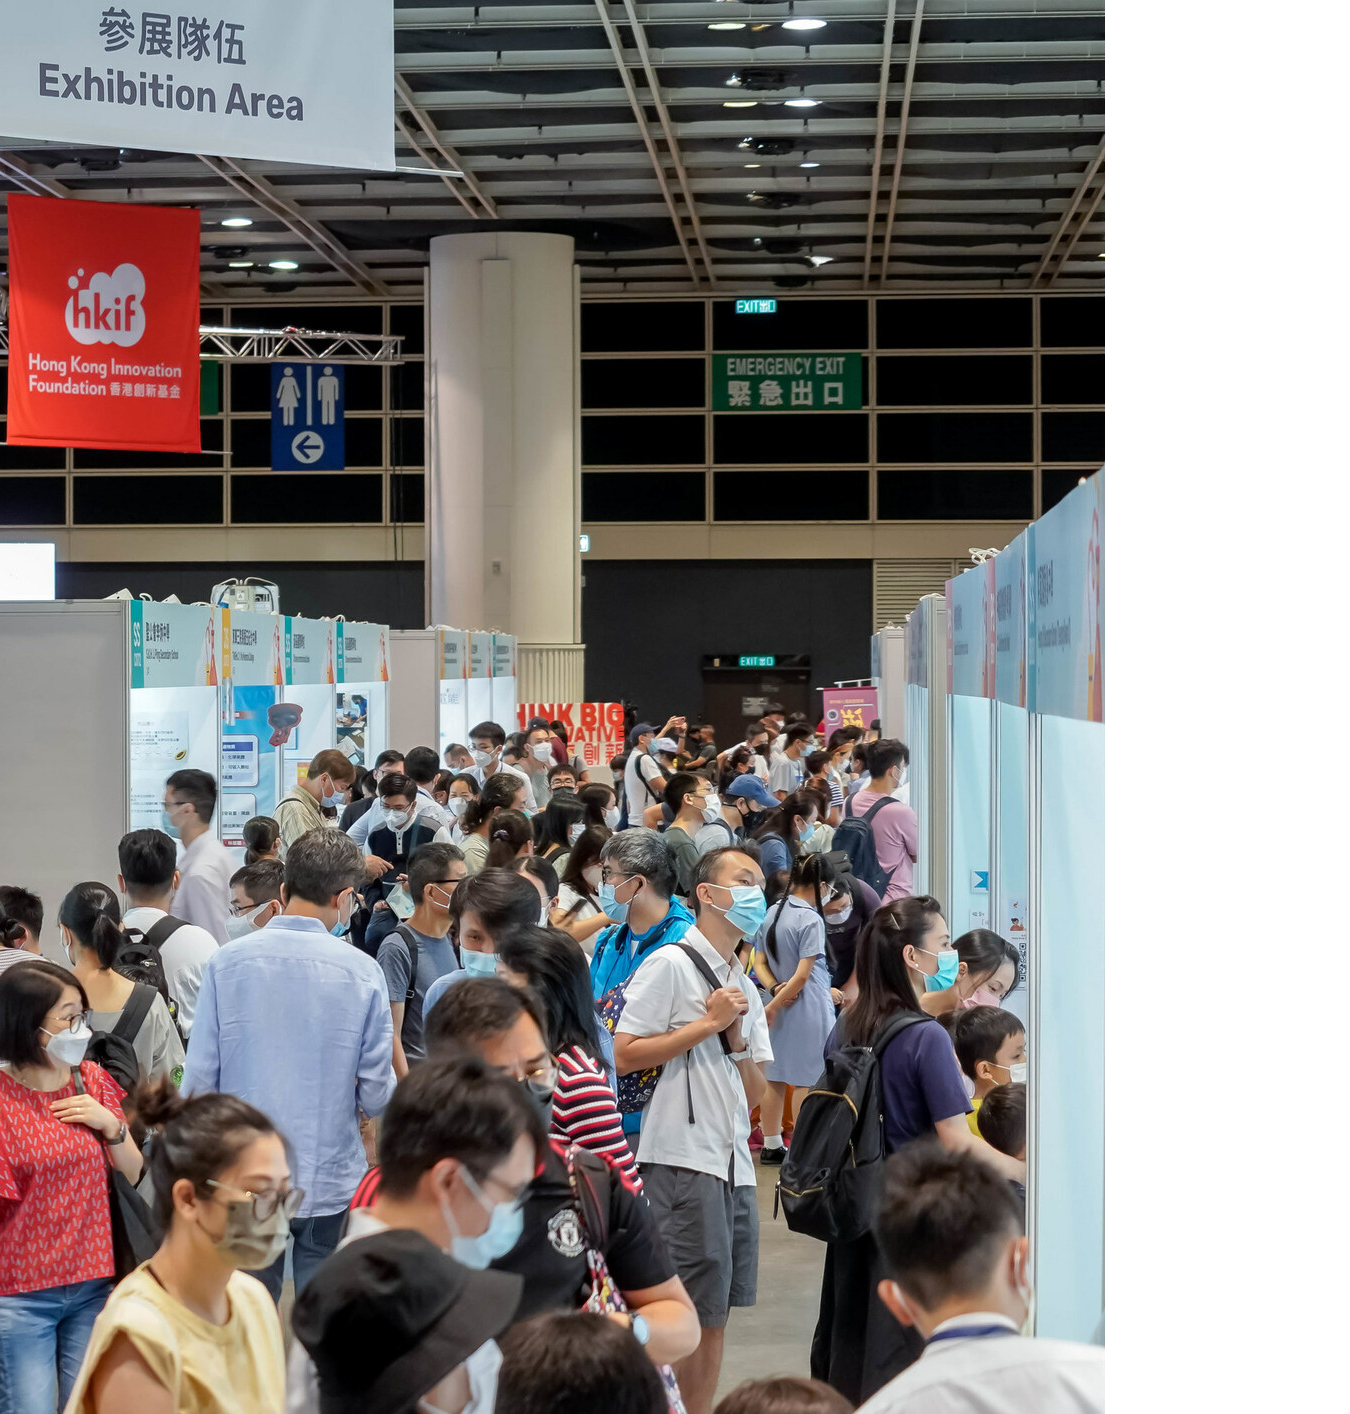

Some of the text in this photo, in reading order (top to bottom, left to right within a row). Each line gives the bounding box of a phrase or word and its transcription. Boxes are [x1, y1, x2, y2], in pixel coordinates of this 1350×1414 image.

[98, 6, 247, 66] 參展隊伍
[38, 62, 305, 122] Exhibition Area
[72, 289, 136, 332] hkif
[736, 300, 777, 313] EXIT 出口
[28, 353, 182, 379] Hong Kong Innovation
[727, 357, 846, 376] EMERGENCY EXIT
[28, 375, 182, 399] Foundation 香港創新基金
[727, 379, 844, 406] 緊急出口
[740, 656, 758, 666] EXIT
[580, 702, 625, 728] BIG
